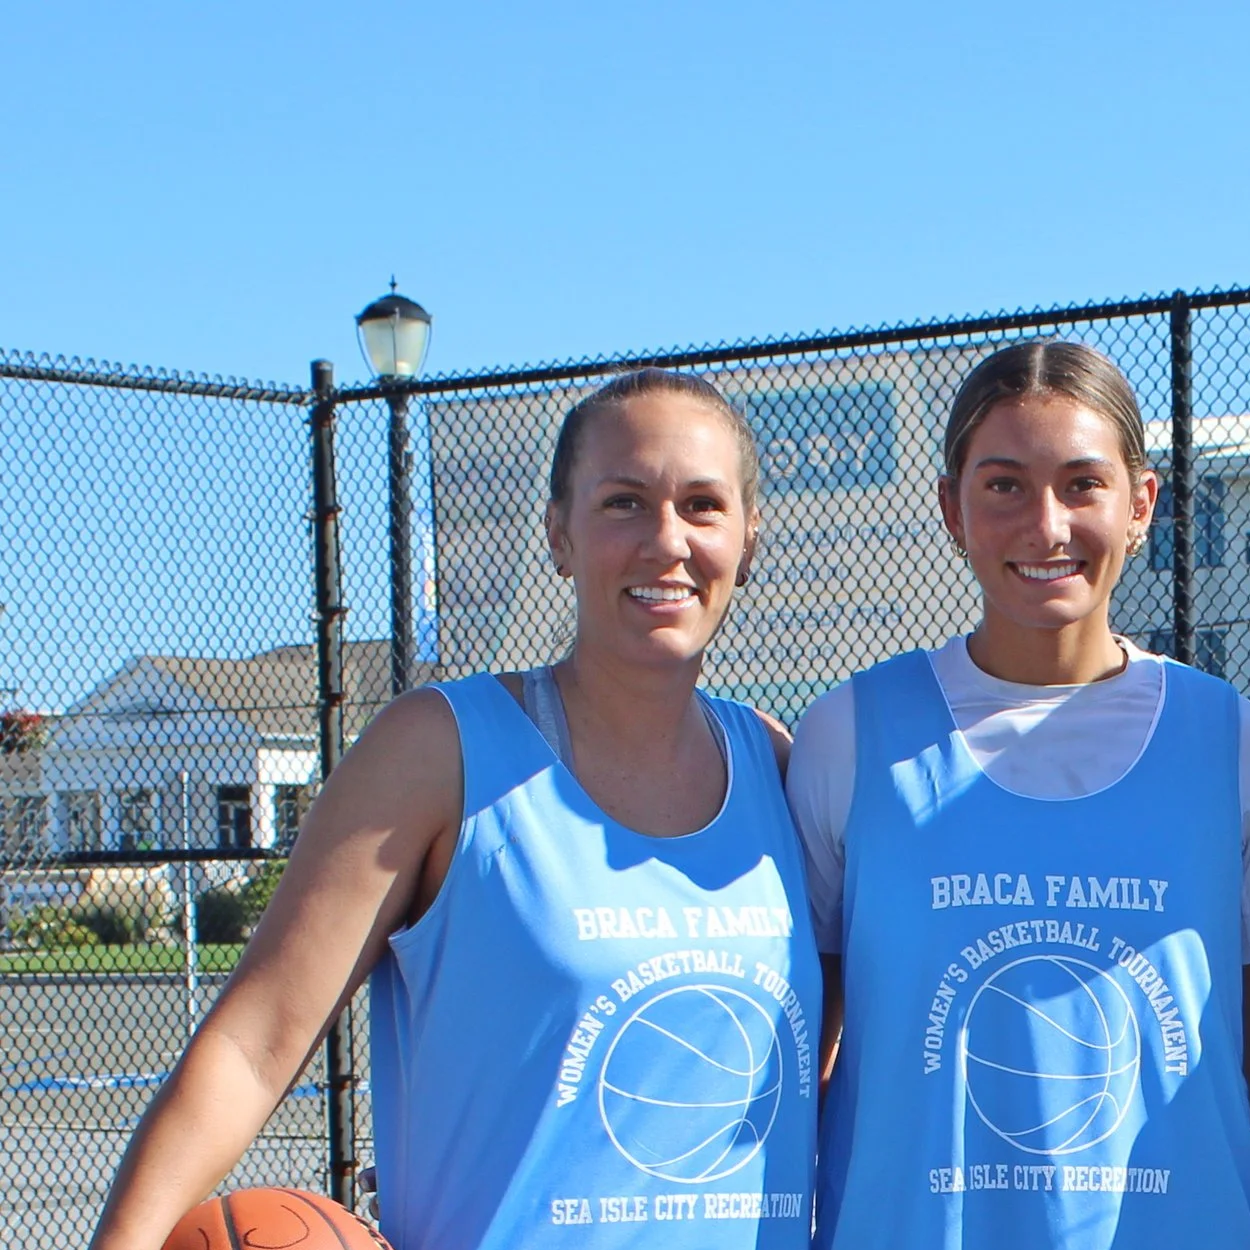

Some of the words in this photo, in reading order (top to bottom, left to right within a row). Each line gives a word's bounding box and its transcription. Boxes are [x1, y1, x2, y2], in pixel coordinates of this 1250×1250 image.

[931, 873, 1034, 910] BRACA
[1045, 876, 1168, 912] FAMILY
[574, 907, 677, 940] BRACA
[682, 906, 793, 938] FAMILY
[924, 963, 969, 1075] WOMEN'S
[960, 920, 1100, 971] BASKETBALL
[1108, 936, 1189, 1077] TOURNAMENT
[557, 994, 616, 1108] WOMEN'S
[611, 950, 745, 1002] BASKETBALL
[754, 962, 811, 1098] TOURNAMENT
[930, 1167, 965, 1193] SEA
[970, 1164, 1007, 1190] ISLE
[1014, 1165, 1057, 1191] CITY
[552, 1197, 593, 1225] SEA
[600, 1195, 648, 1223] ISLE
[654, 1193, 698, 1220] CITY
[704, 1193, 803, 1220] RECREATION
